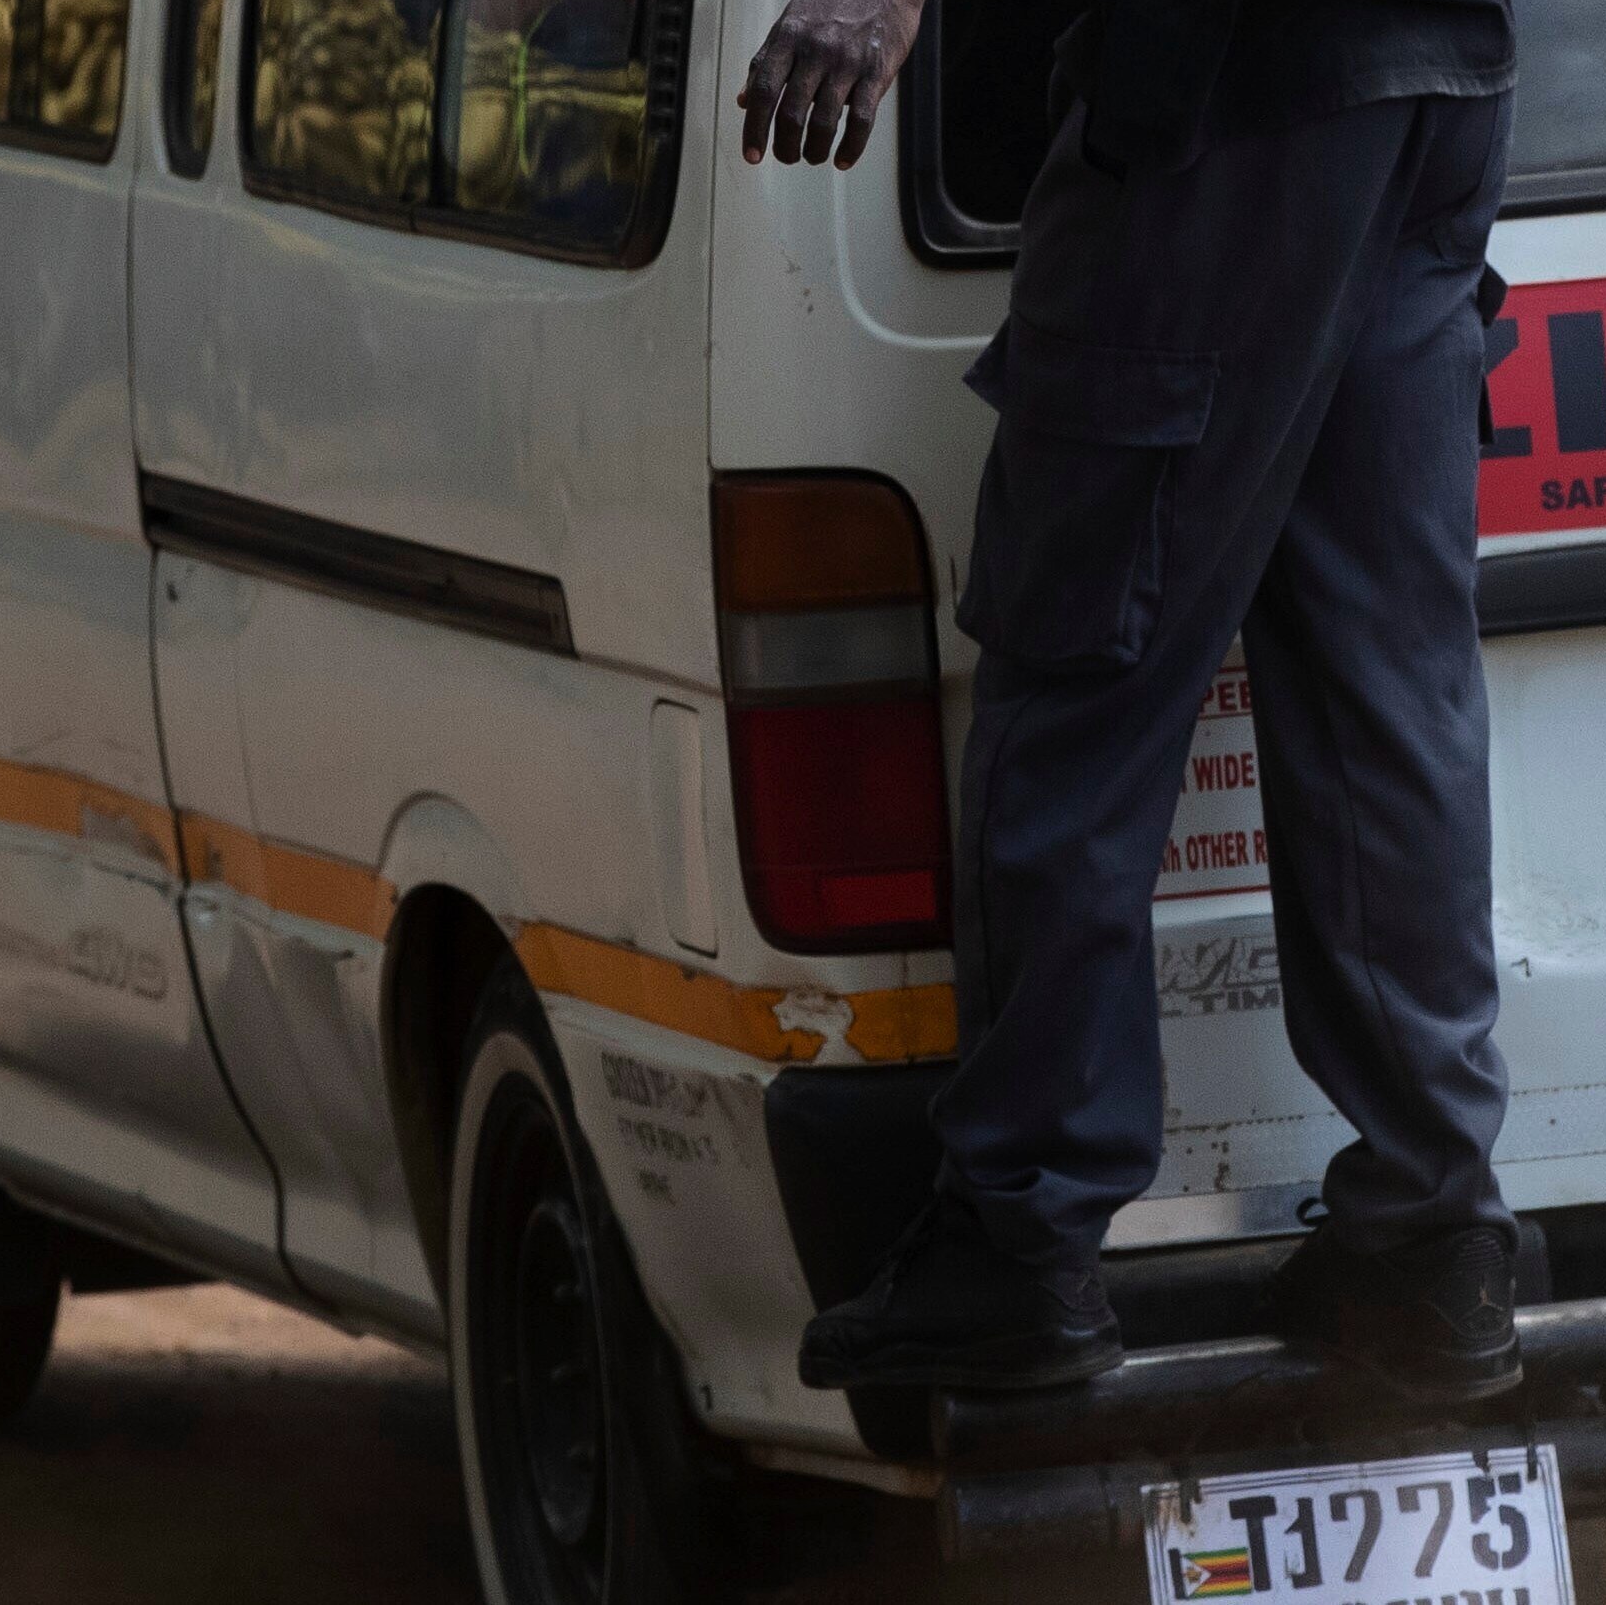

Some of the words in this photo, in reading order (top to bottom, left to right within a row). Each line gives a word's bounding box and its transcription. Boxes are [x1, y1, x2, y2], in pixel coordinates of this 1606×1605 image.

[1192, 752, 1256, 792] WIDE
[1186, 831, 1248, 872] OTHER
[1189, 987, 1280, 1013] TIM
